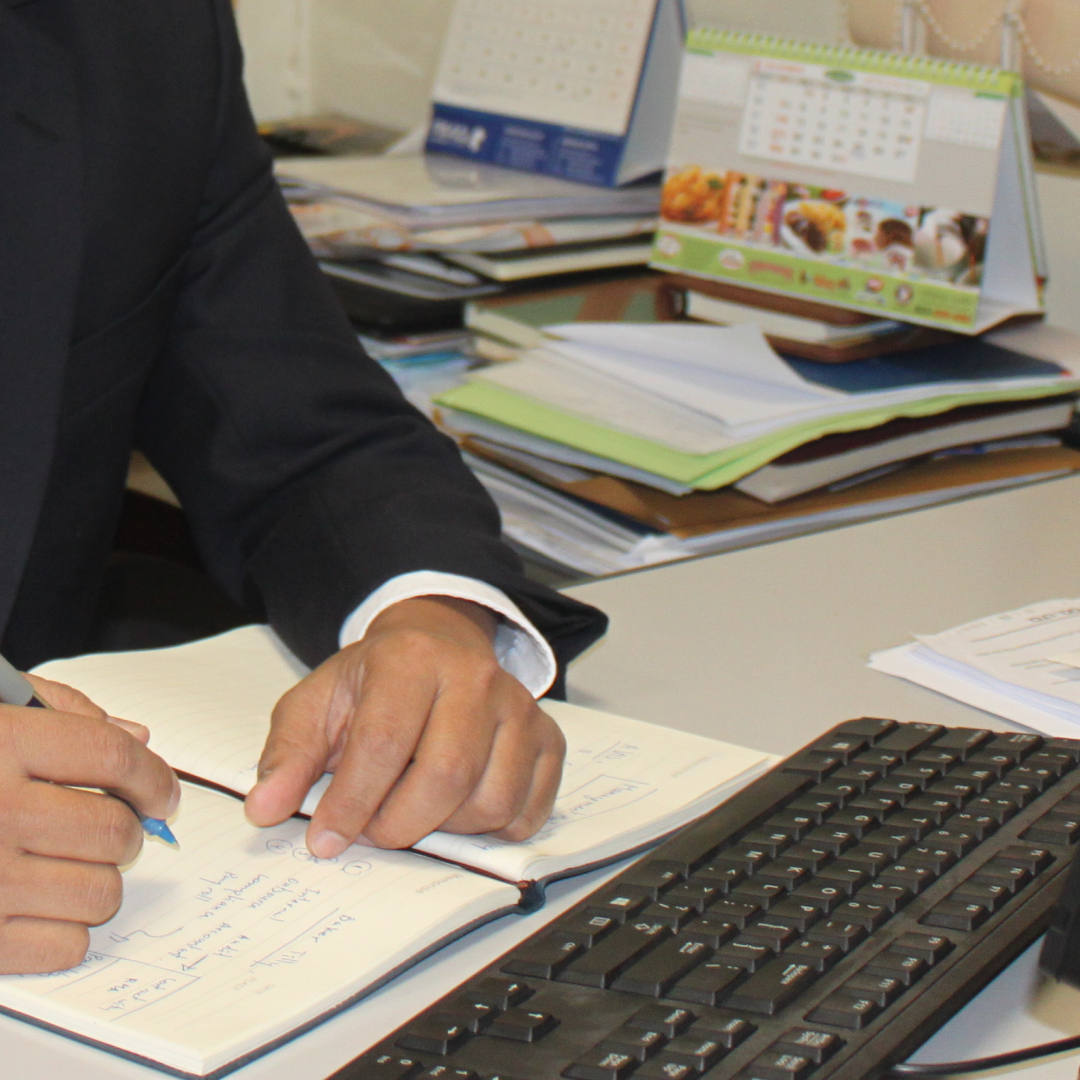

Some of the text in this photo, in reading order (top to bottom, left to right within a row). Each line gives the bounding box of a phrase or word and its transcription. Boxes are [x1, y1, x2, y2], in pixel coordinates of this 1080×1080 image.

[880, 755, 896, 763] Z
[990, 755, 1009, 763] Q
[858, 769, 875, 777] X
[971, 770, 989, 779] W
[898, 782, 914, 790] D
[816, 801, 831, 809] V
[854, 814, 870, 822] G
[770, 833, 787, 841] N
[832, 831, 849, 839] H
[745, 850, 763, 860] M
[868, 851, 884, 859] U
[787, 866, 803, 874] K
[821, 887, 838, 896] O
[800, 905, 815, 913] P
[253, 913, 357, 968] Baker Tilly
